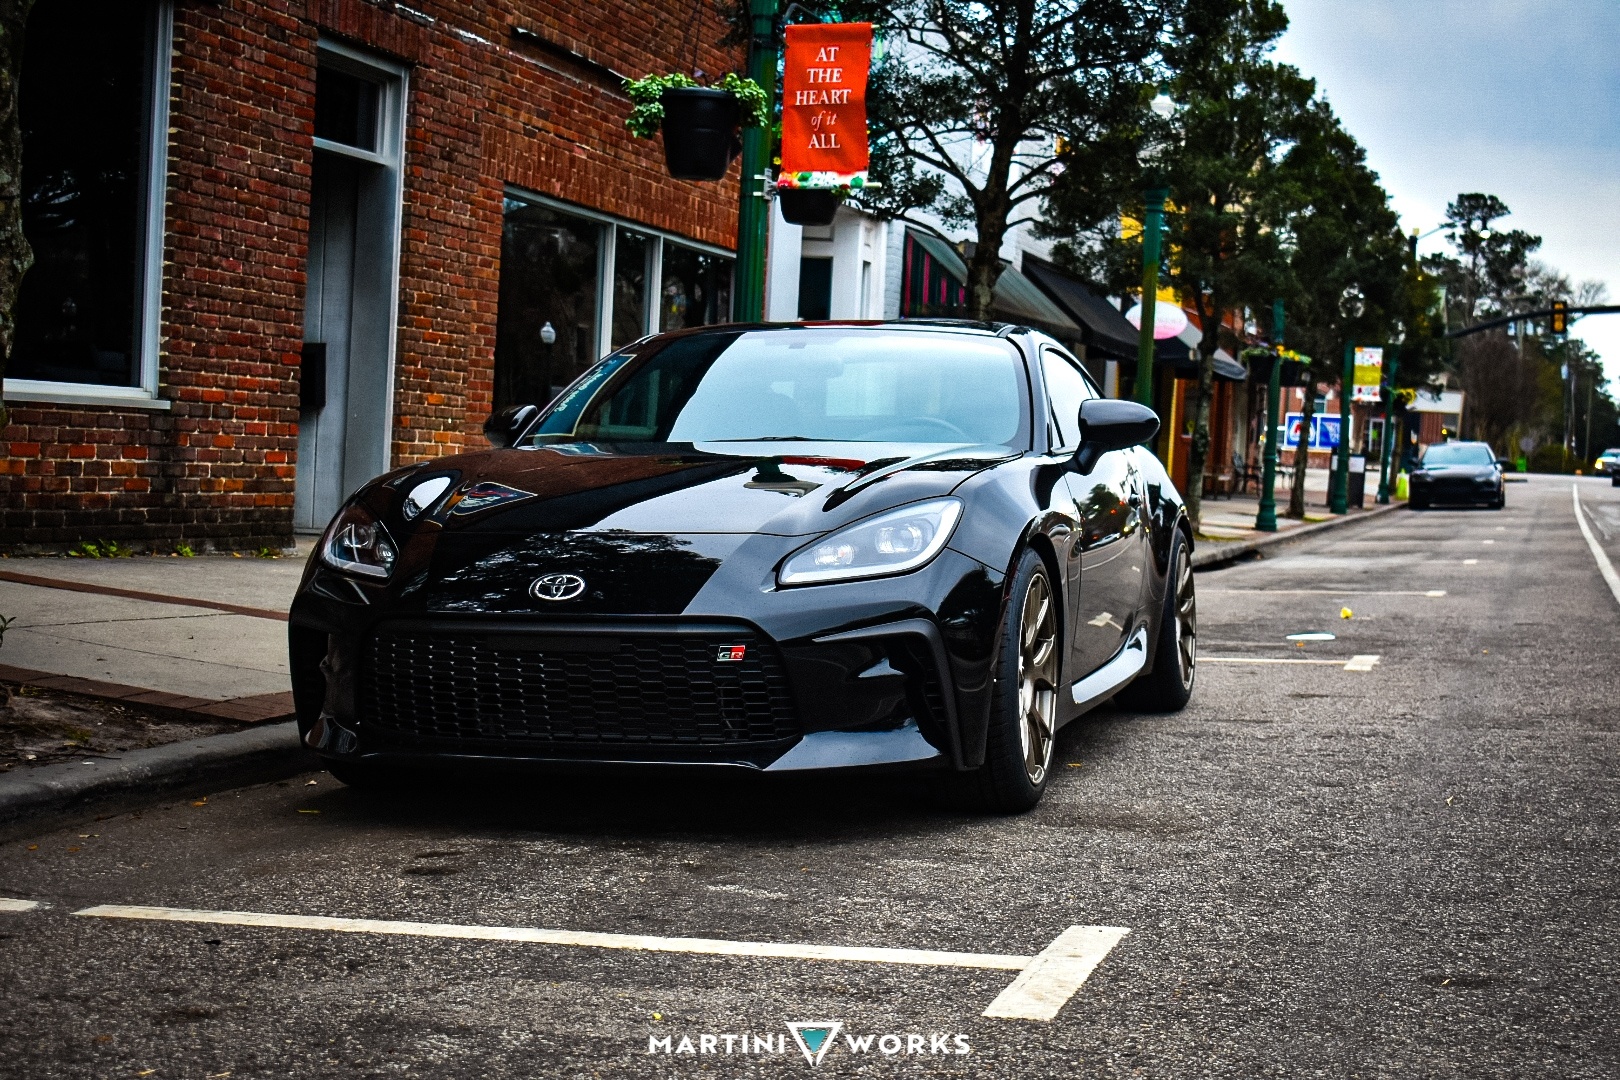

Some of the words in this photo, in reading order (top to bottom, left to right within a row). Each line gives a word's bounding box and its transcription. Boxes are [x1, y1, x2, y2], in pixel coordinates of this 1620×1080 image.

[815, 47, 839, 62] AT
[806, 68, 843, 83] THE
[794, 89, 852, 106] HEART
[811, 110, 826, 132] of
[826, 111, 837, 126] it
[808, 133, 841, 149] ALL
[719, 651, 744, 659] GR
